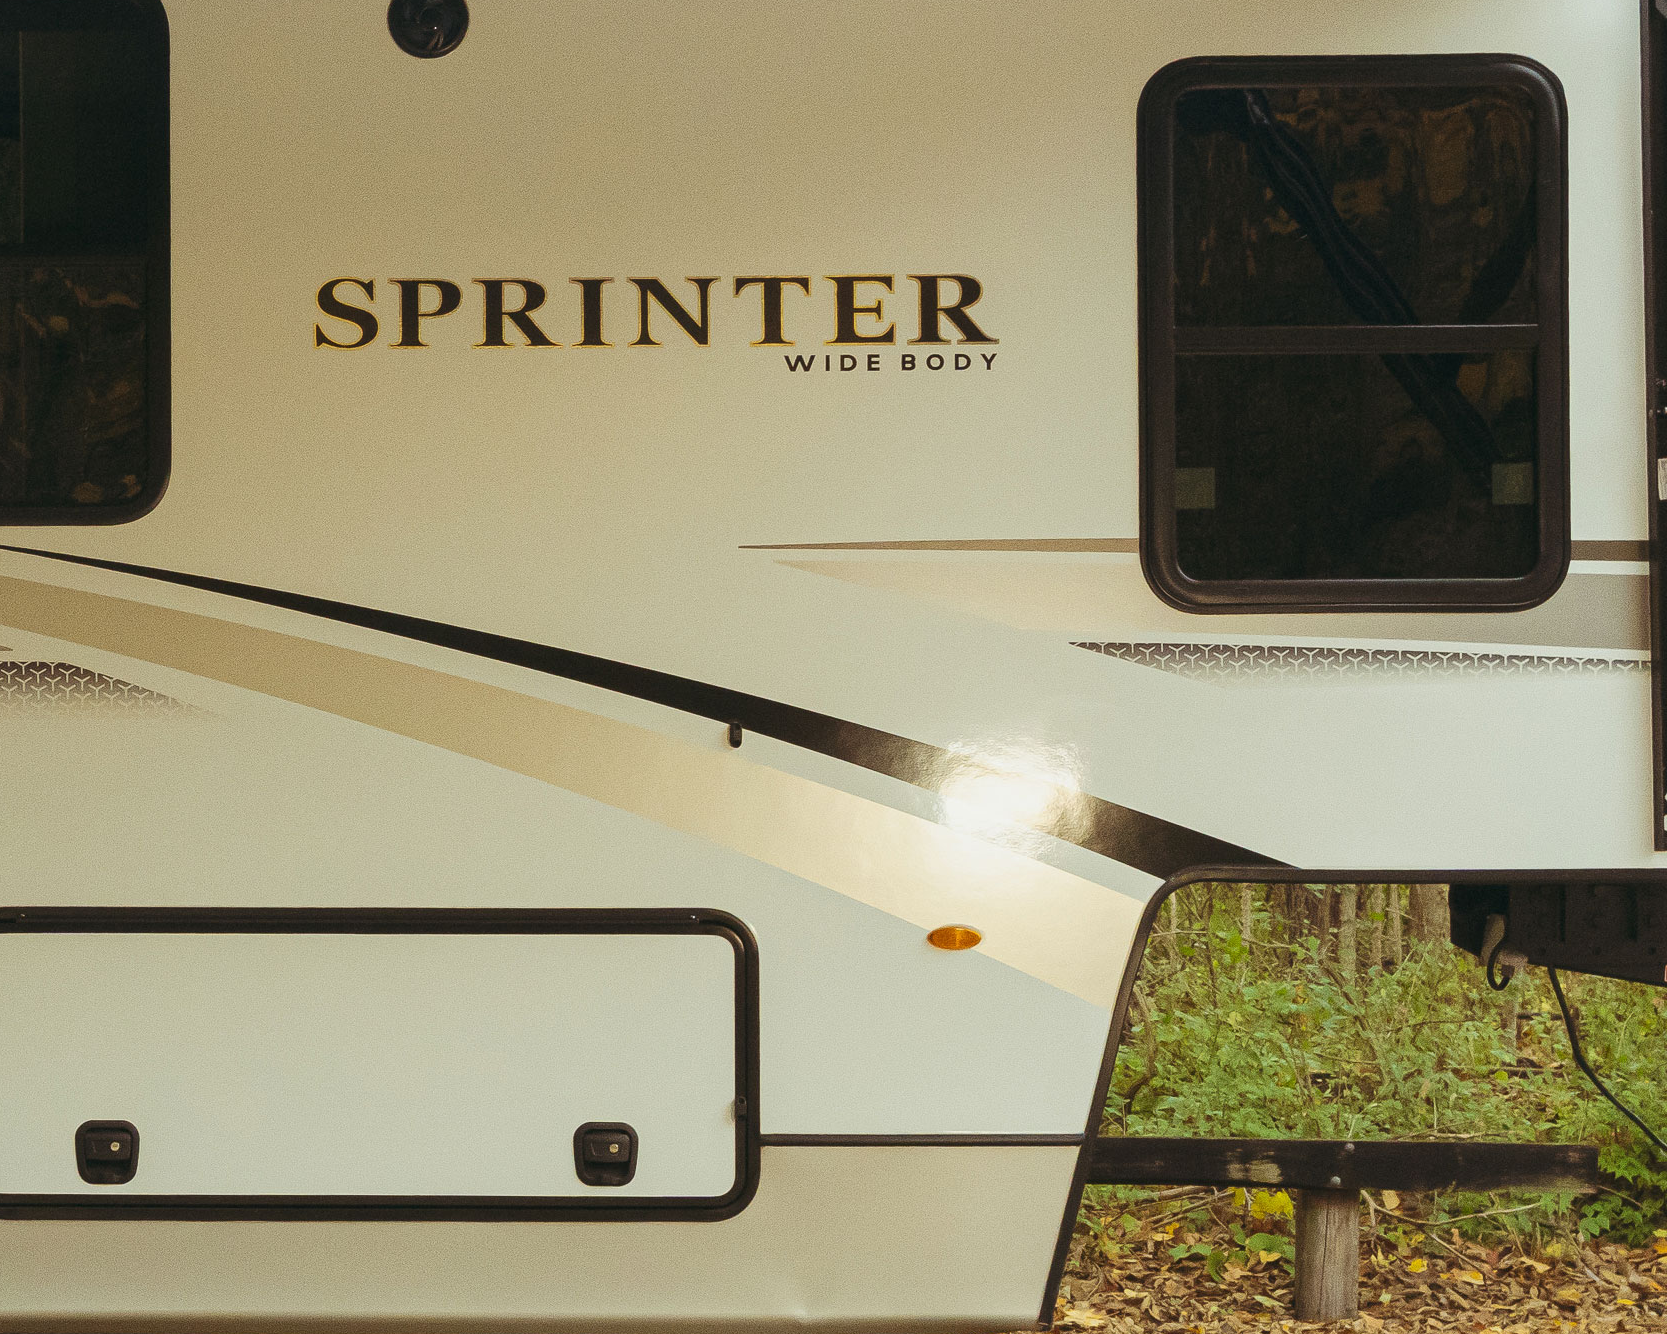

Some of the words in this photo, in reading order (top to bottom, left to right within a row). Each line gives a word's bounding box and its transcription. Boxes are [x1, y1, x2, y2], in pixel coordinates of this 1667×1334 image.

[314, 273, 1000, 350] SPRINTER
[784, 354, 882, 373] WIDE
[901, 353, 999, 373] BODY
